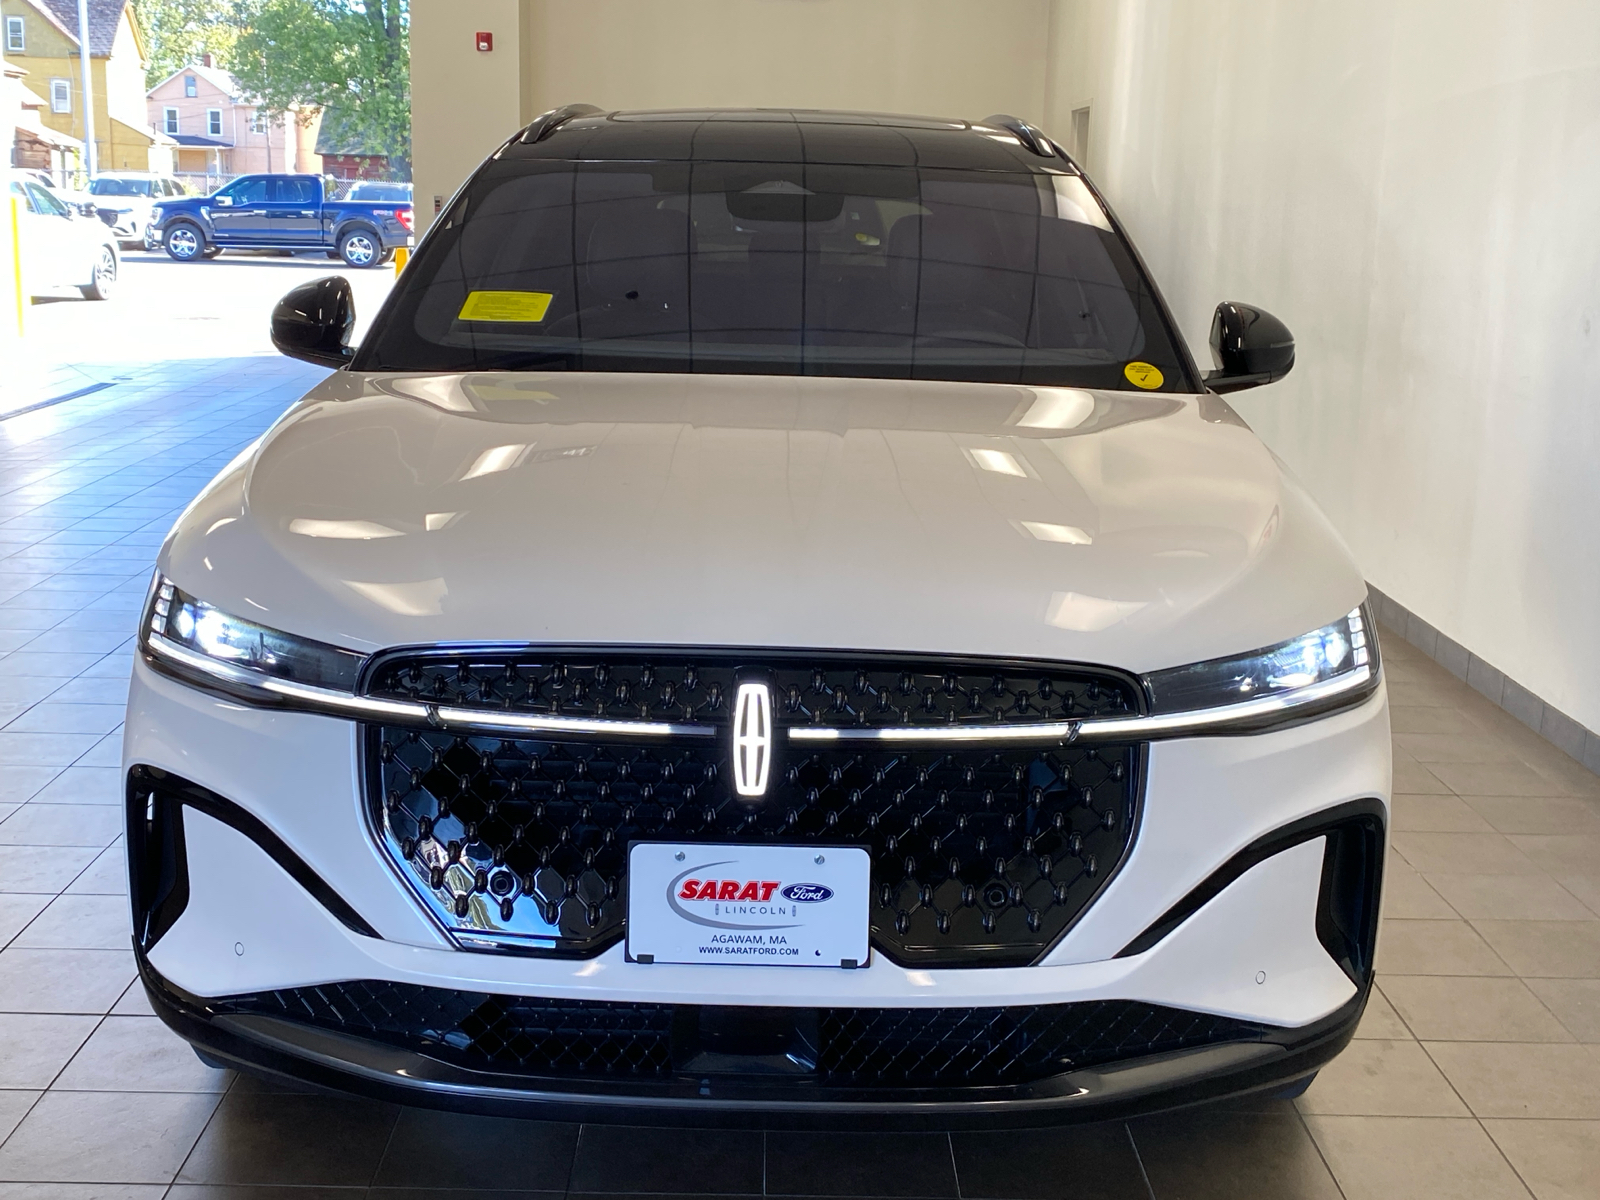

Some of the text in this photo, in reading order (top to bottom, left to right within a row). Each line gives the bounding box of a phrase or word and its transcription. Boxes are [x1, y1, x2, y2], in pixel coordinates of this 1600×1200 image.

[679, 879, 824, 902] SARAT Ford
[725, 906, 786, 915] LINCOLN
[711, 935, 787, 946] AGAWAM, MA
[698, 946, 799, 956] WWW.SARATFORD.COM
